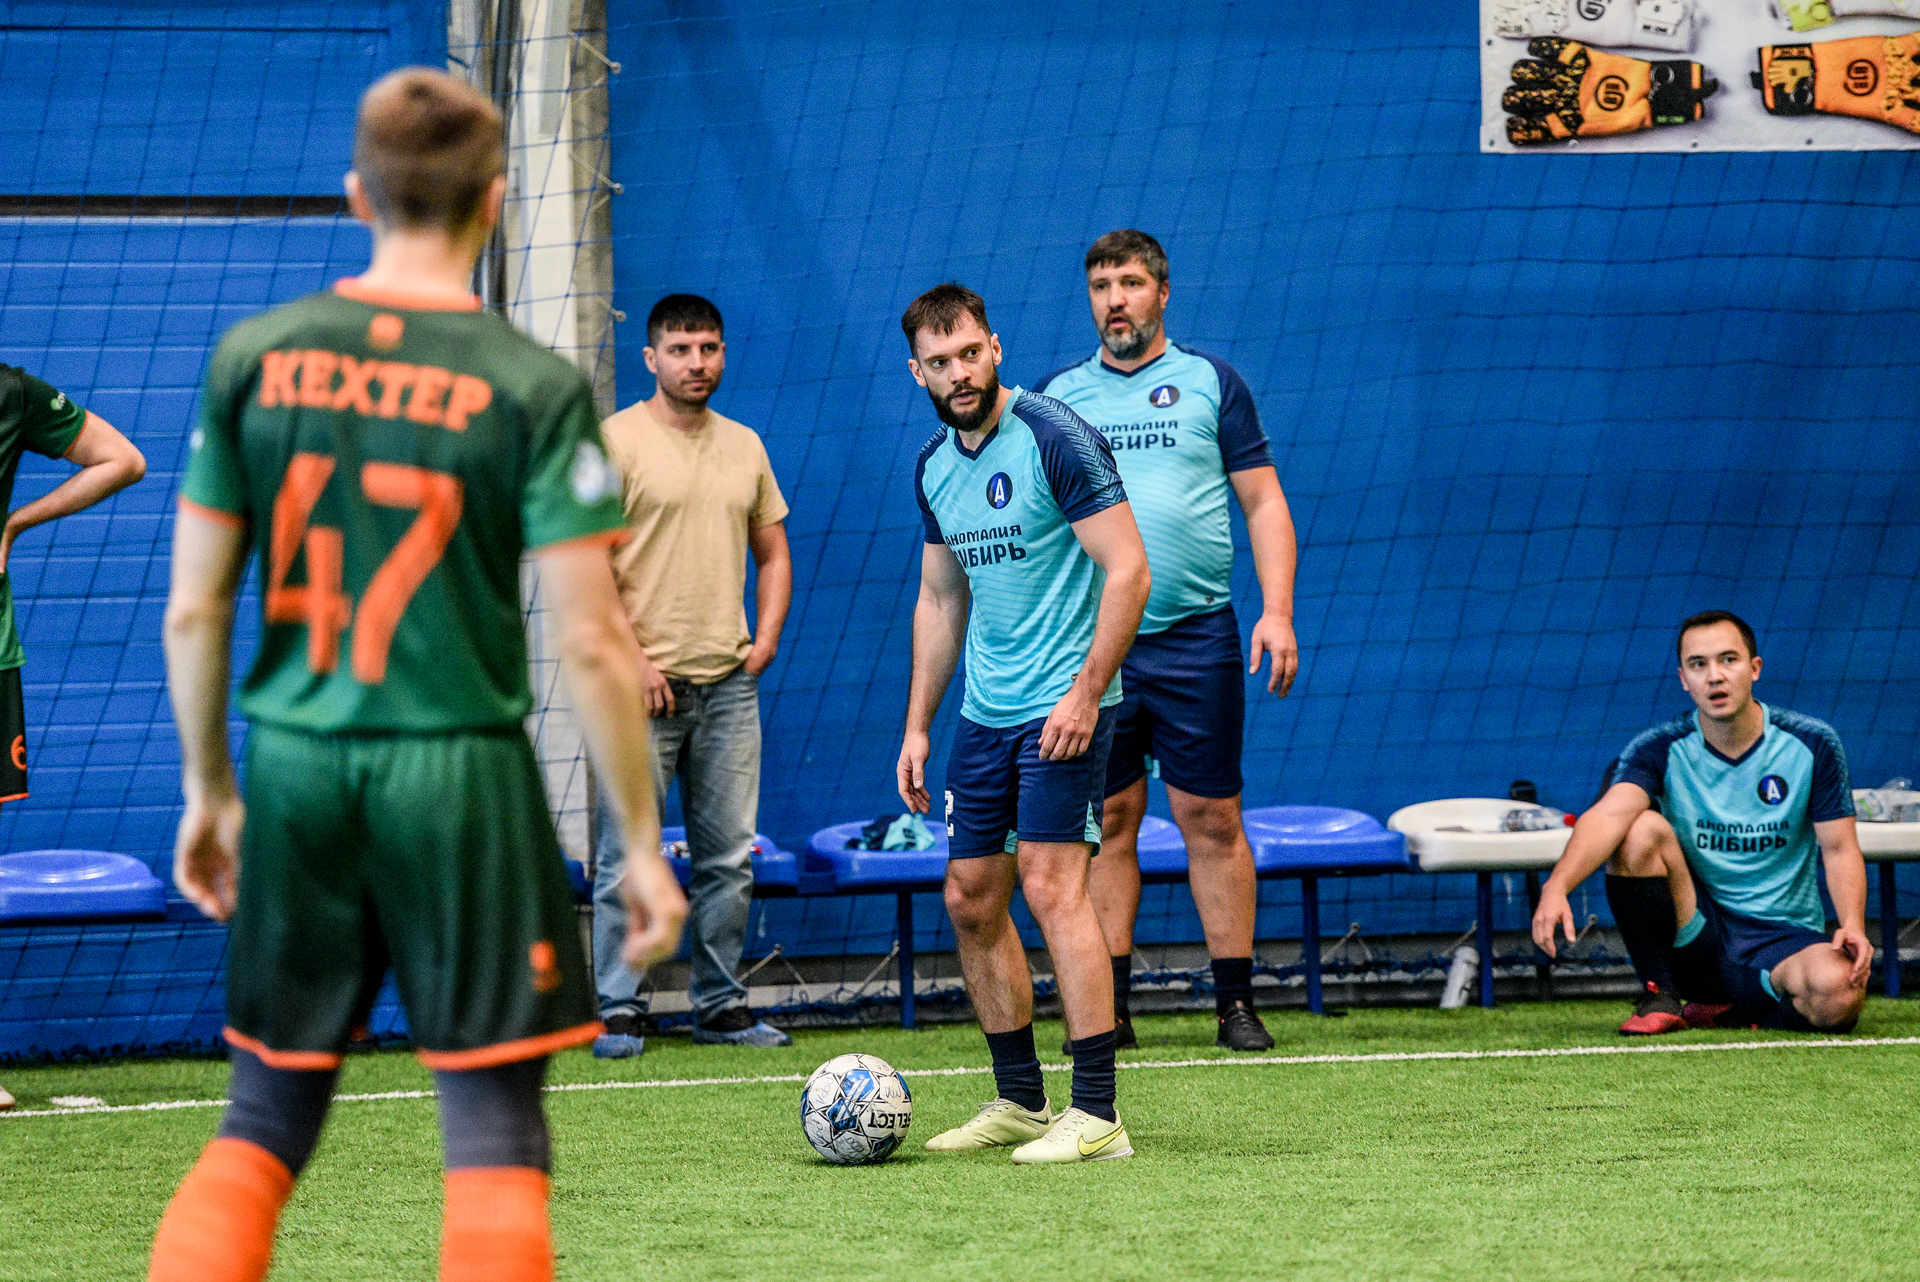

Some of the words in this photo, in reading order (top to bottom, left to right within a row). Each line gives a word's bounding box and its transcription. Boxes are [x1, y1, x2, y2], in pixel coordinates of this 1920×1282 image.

[259, 348, 493, 432] КЕХТЕР
[1098, 420, 1178, 433] ОМАЛИЯ
[1110, 432, 1176, 451] БИРЬ
[265, 451, 464, 684] 47
[1696, 819, 1789, 833] АНОМАЛИЯ
[1697, 833, 1787, 852] СИБИРЬ
[868, 1112, 911, 1129] SELECT
